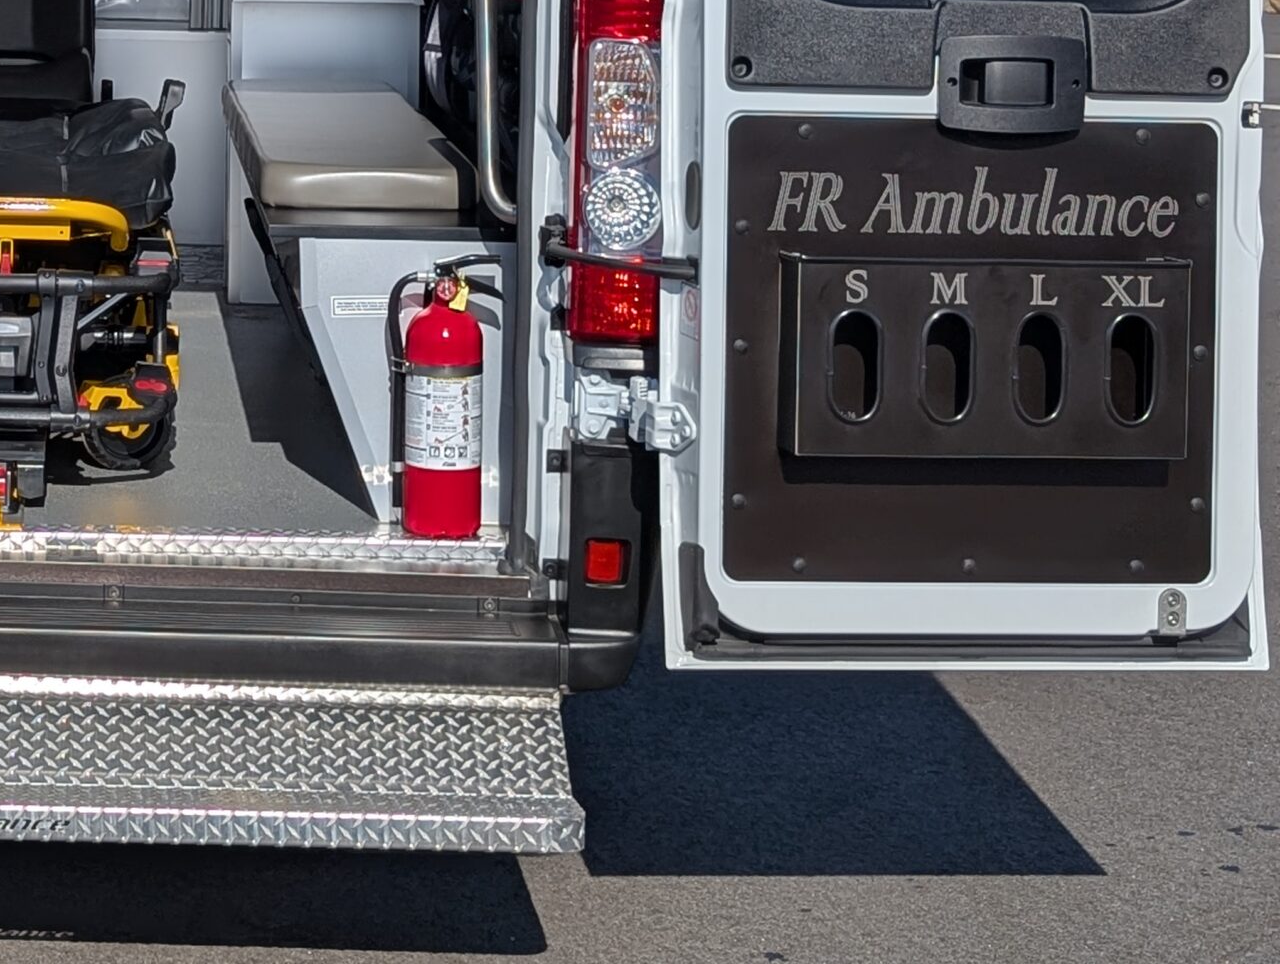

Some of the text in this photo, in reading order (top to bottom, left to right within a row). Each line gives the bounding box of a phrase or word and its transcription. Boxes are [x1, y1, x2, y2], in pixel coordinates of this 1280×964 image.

[767, 166, 1180, 238] FR Ambulance
[844, 269, 869, 304] S
[930, 272, 969, 305] M
[1029, 273, 1058, 306] L
[1101, 275, 1165, 307] XL
